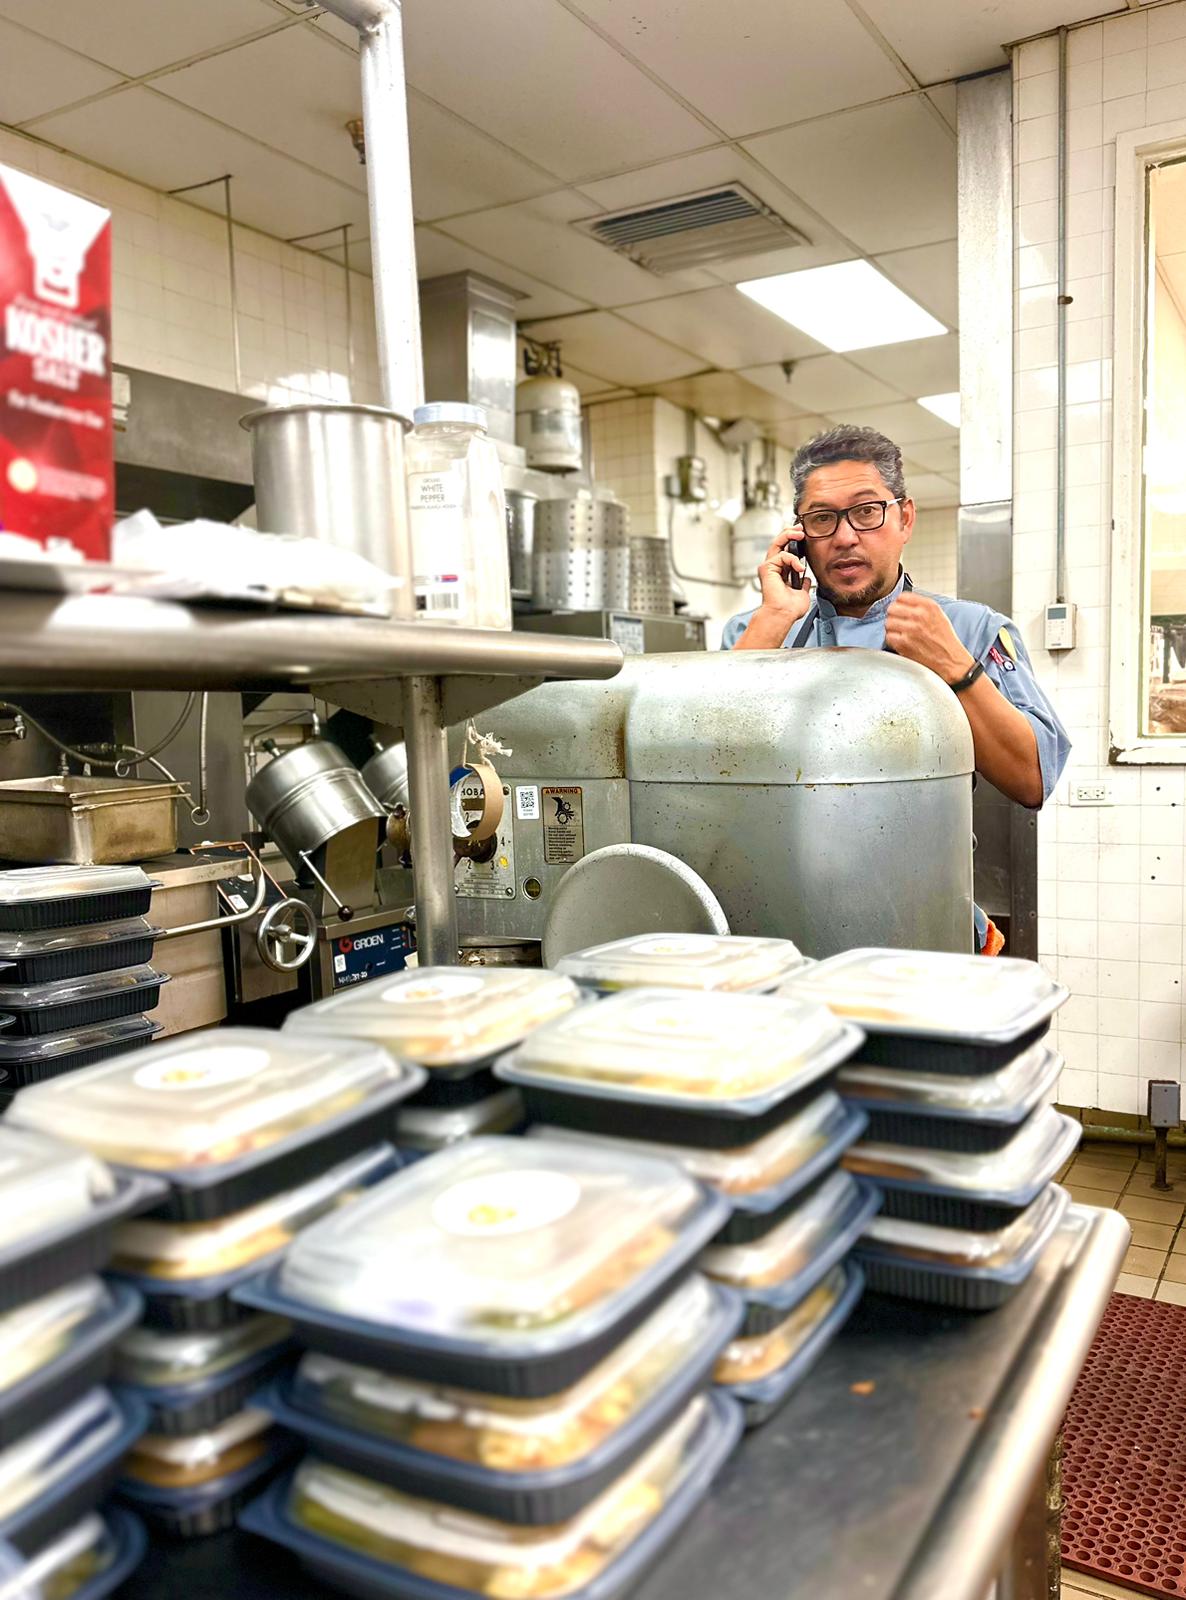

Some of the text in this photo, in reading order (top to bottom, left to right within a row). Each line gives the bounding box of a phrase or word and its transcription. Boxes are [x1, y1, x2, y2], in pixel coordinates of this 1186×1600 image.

[6, 304, 106, 376] KOSHER
[420, 483, 444, 493] WHITE
[420, 493, 445, 503] PEPPER
[353, 934, 384, 950] GROEN
